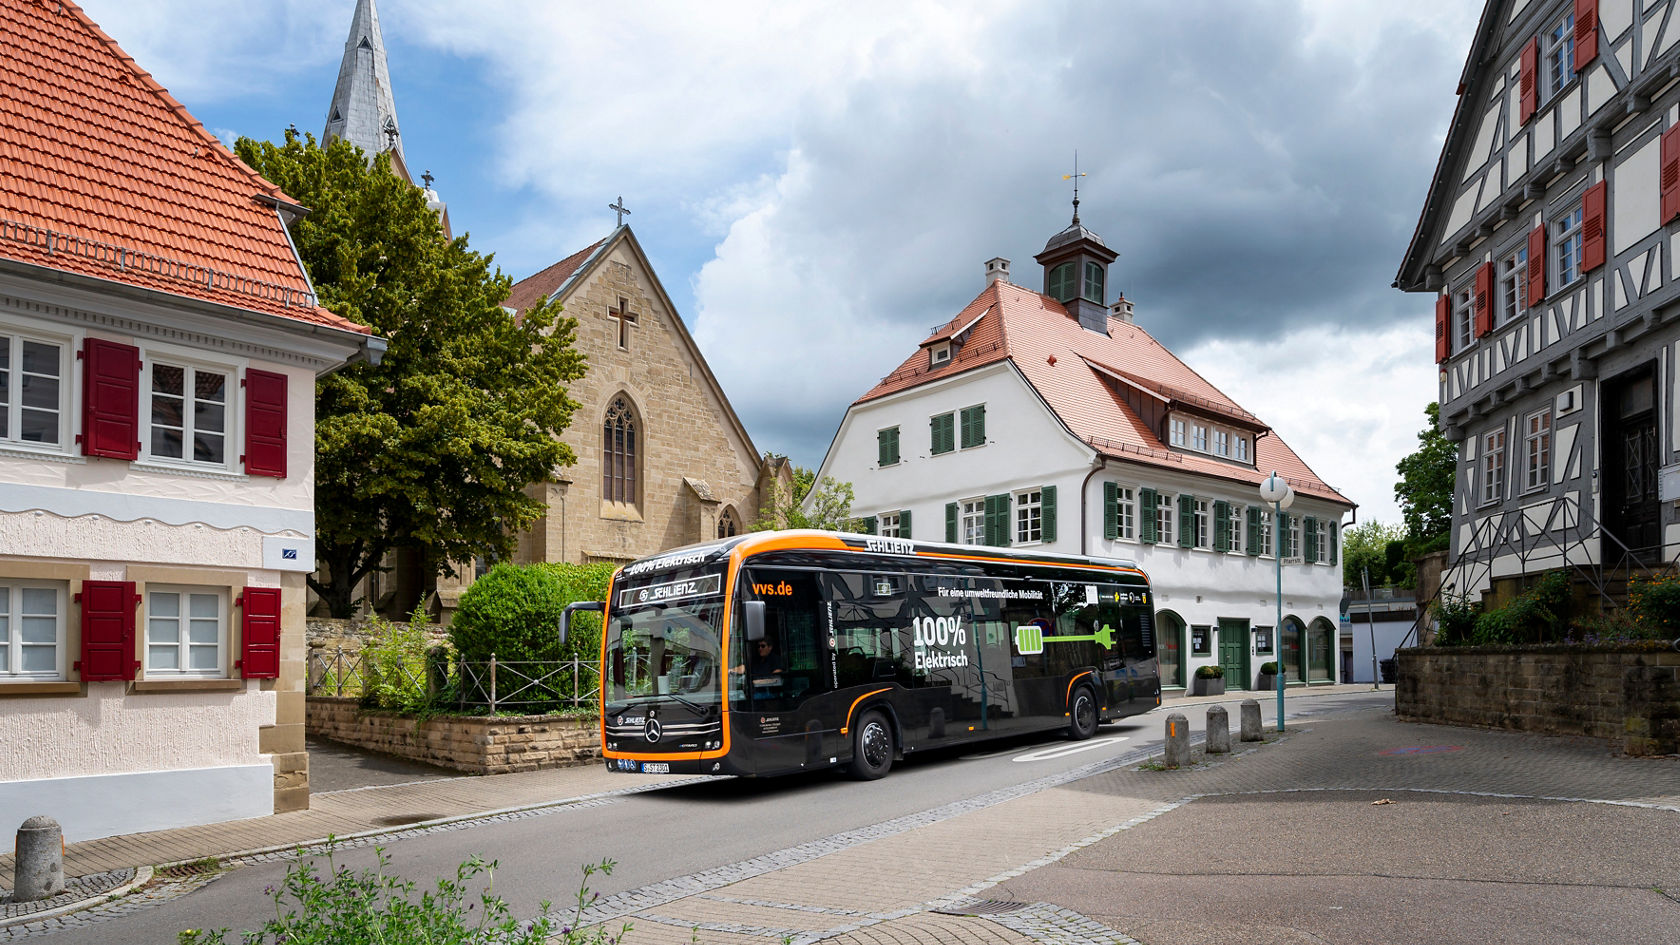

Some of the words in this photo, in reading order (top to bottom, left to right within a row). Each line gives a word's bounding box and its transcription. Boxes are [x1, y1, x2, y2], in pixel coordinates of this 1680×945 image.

[629, 559, 656, 576] 100%
[655, 551, 706, 570] Elektrisch
[752, 580, 793, 596] vvs.de
[937, 587, 949, 598] Für
[950, 587, 964, 598] eine
[965, 588, 1018, 599] umweltfreundliche
[1019, 589, 1043, 600] Mobilität
[913, 615, 966, 647] 100%
[914, 650, 968, 670] Elektrisch
